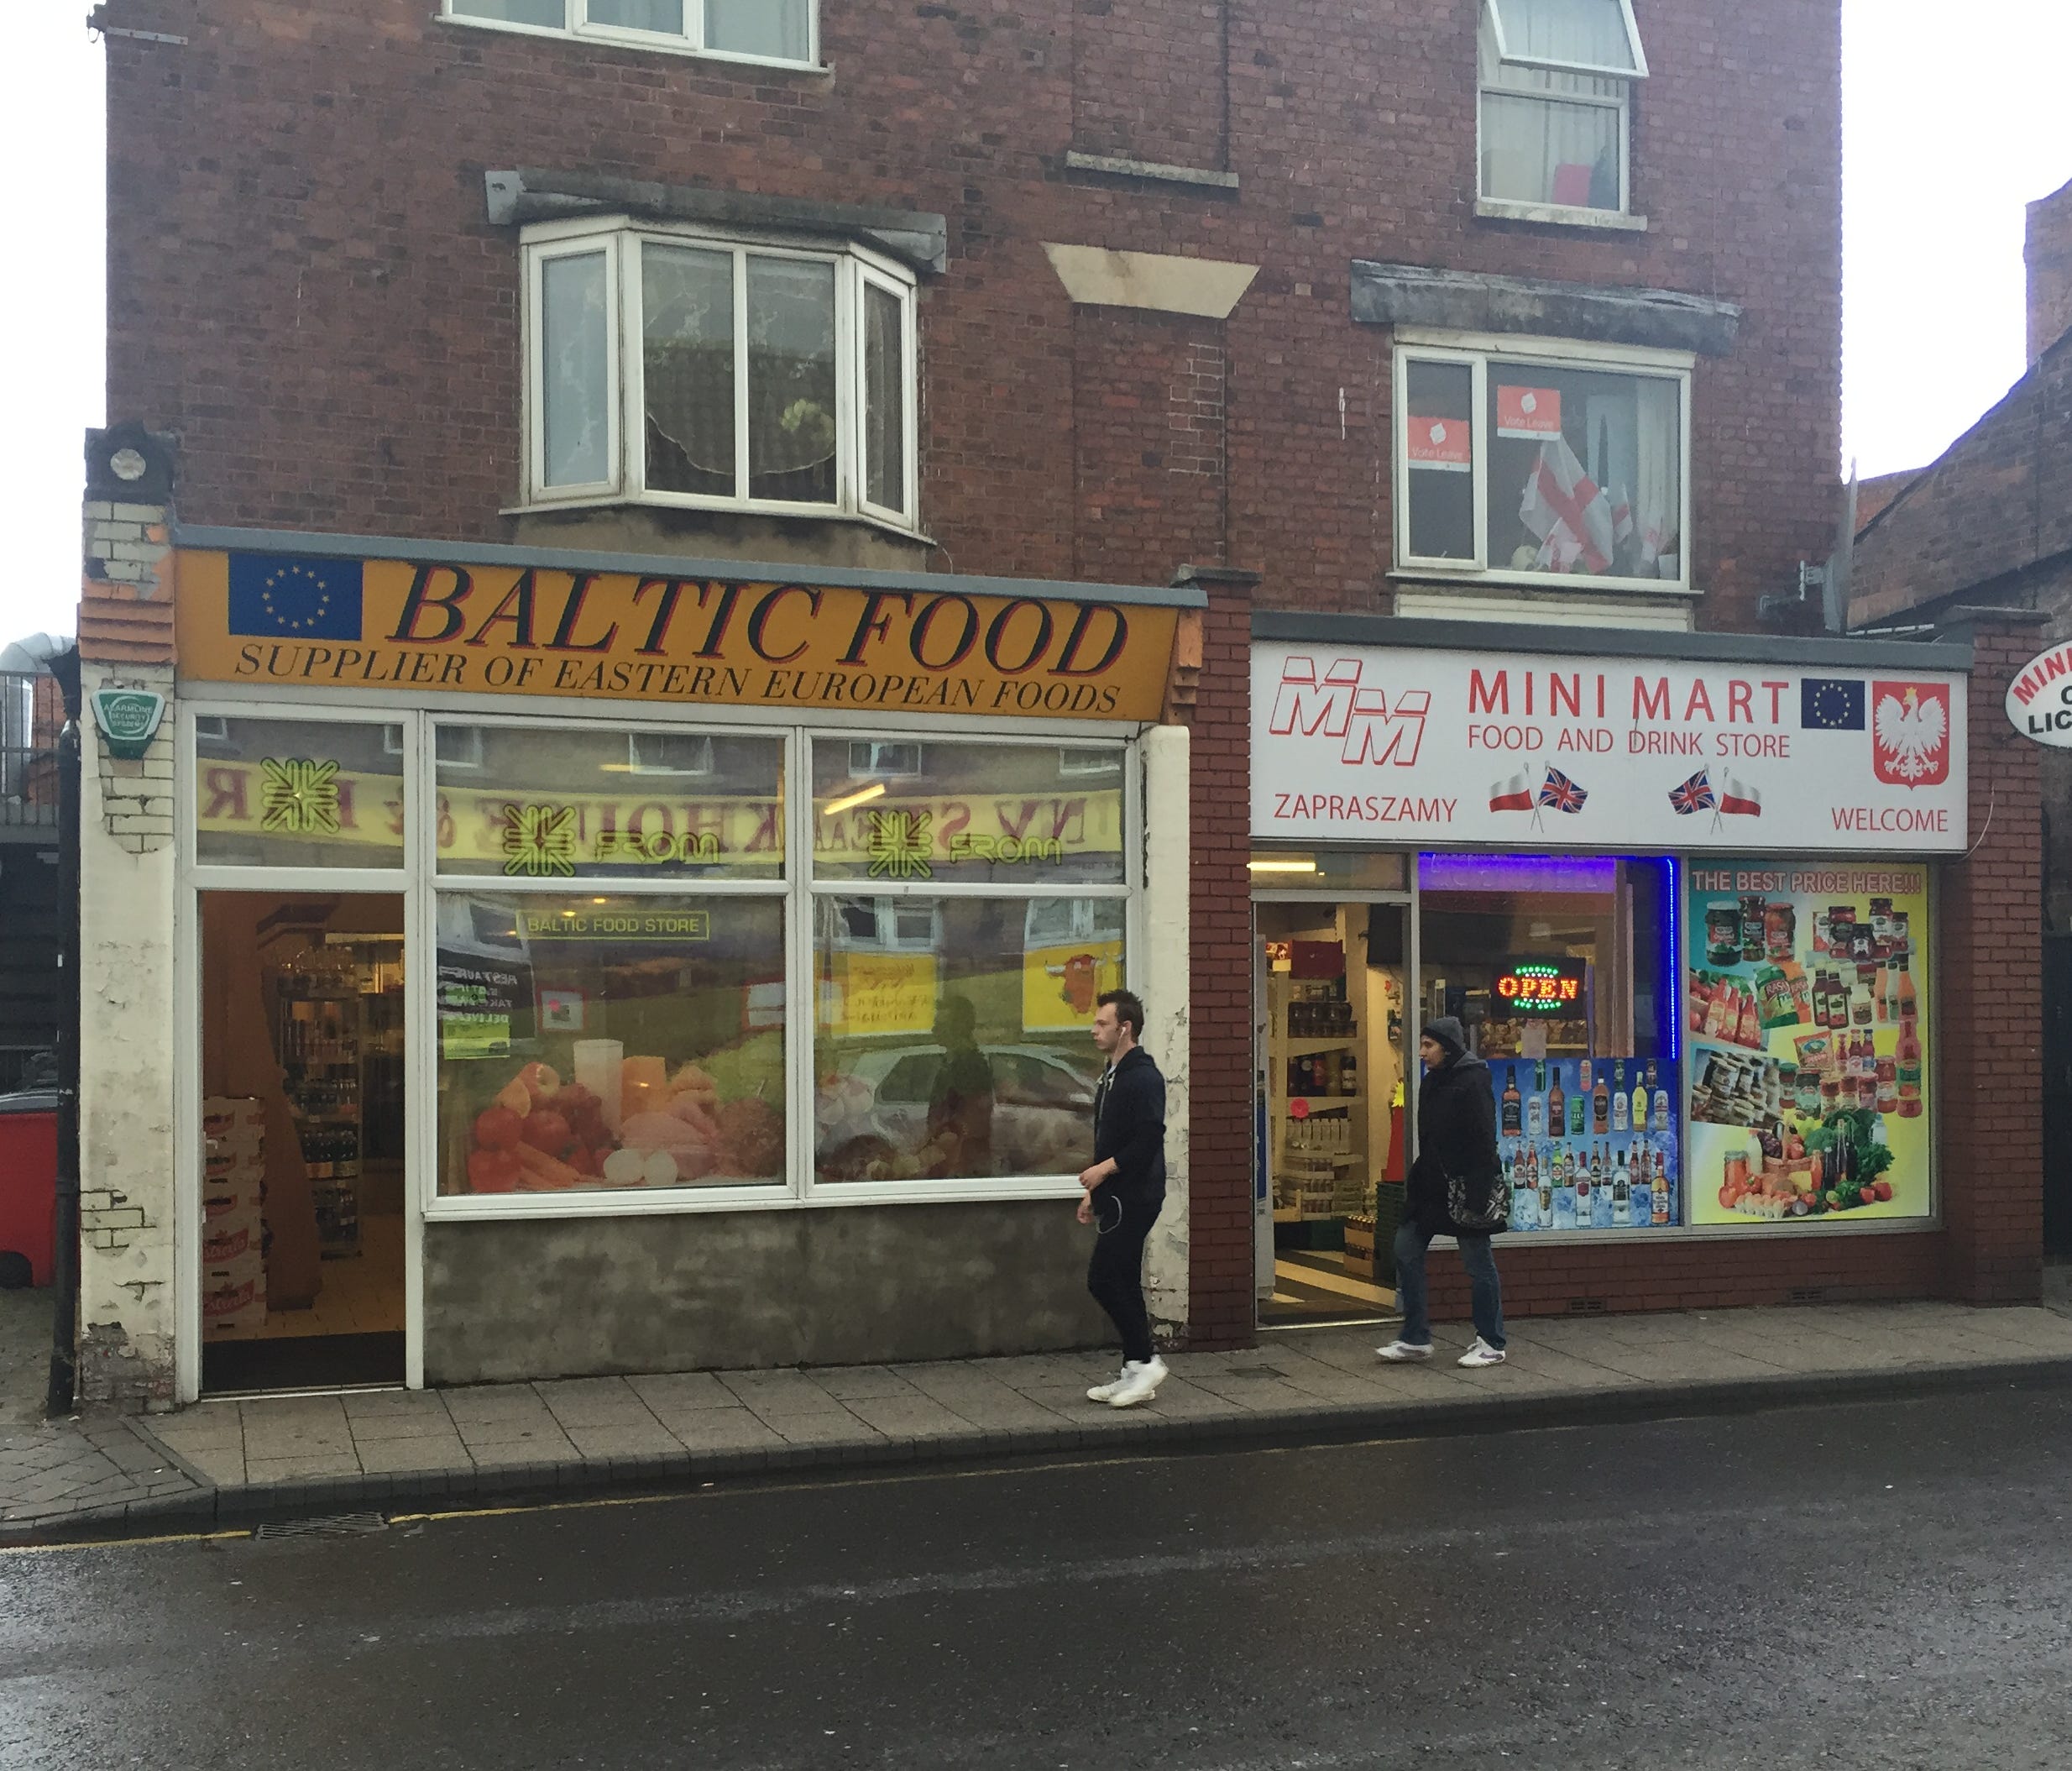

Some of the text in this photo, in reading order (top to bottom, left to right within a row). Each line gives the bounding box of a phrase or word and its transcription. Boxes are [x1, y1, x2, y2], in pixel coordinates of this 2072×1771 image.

[1504, 415, 1554, 429] Vote Leave
[1412, 446, 1464, 460] Vote Leave
[385, 563, 1129, 678] BALTIC FOOD
[235, 644, 1121, 715] SUPPLIER OF EASTERN EUROPEAN FOODS
[1468, 668, 1789, 724] MINI MART
[1468, 725, 1791, 758] FOOD AND DRINK STORE
[1274, 793, 1457, 823] ZAPRASZAMY
[1832, 807, 1949, 832] WELCOME
[1692, 870, 1923, 895] THE BEST PRICE HERE!!!
[527, 918, 699, 933] BALTIC FOOD STORE
[1498, 977, 1578, 1000] OPEN
